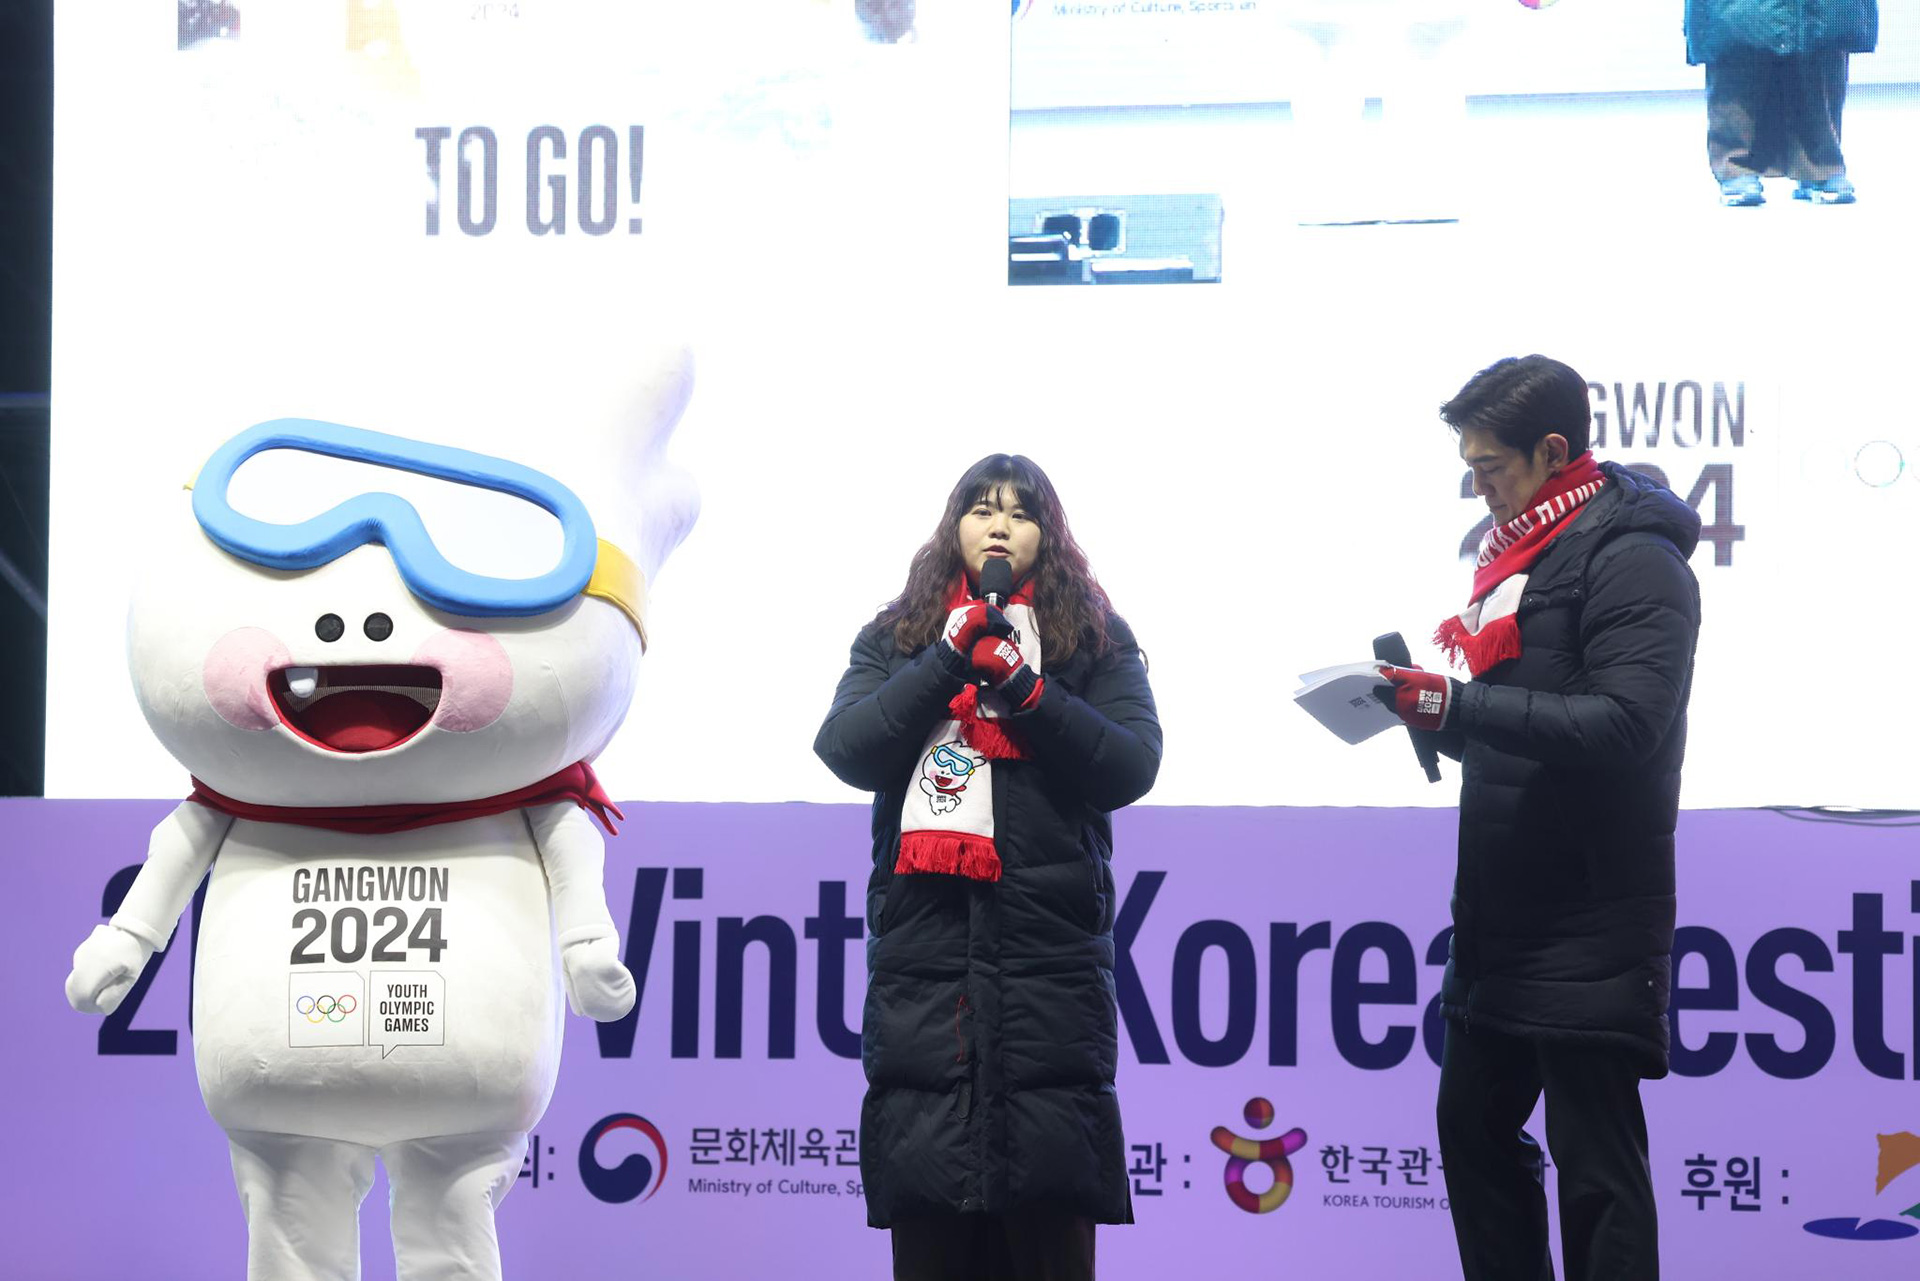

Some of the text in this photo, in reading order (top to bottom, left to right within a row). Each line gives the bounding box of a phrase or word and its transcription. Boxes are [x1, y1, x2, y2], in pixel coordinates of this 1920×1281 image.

[415, 124, 645, 237] TO GO!
[292, 866, 449, 903] GANGWON
[290, 906, 448, 965] 2024
[387, 984, 428, 998] YOUTH
[379, 1001, 434, 1016] OLYMPIC
[384, 1018, 429, 1033] GAMES
[1319, 1144, 1444, 1186] 한국관
[688, 1178, 751, 1197] Ministry
[756, 1179, 773, 1194] of
[778, 1179, 841, 1196] Culture,
[1681, 1153, 1761, 1212] 후원
[1323, 1195, 1370, 1208] KOREA
[1373, 1196, 1435, 1210] TOURISM
